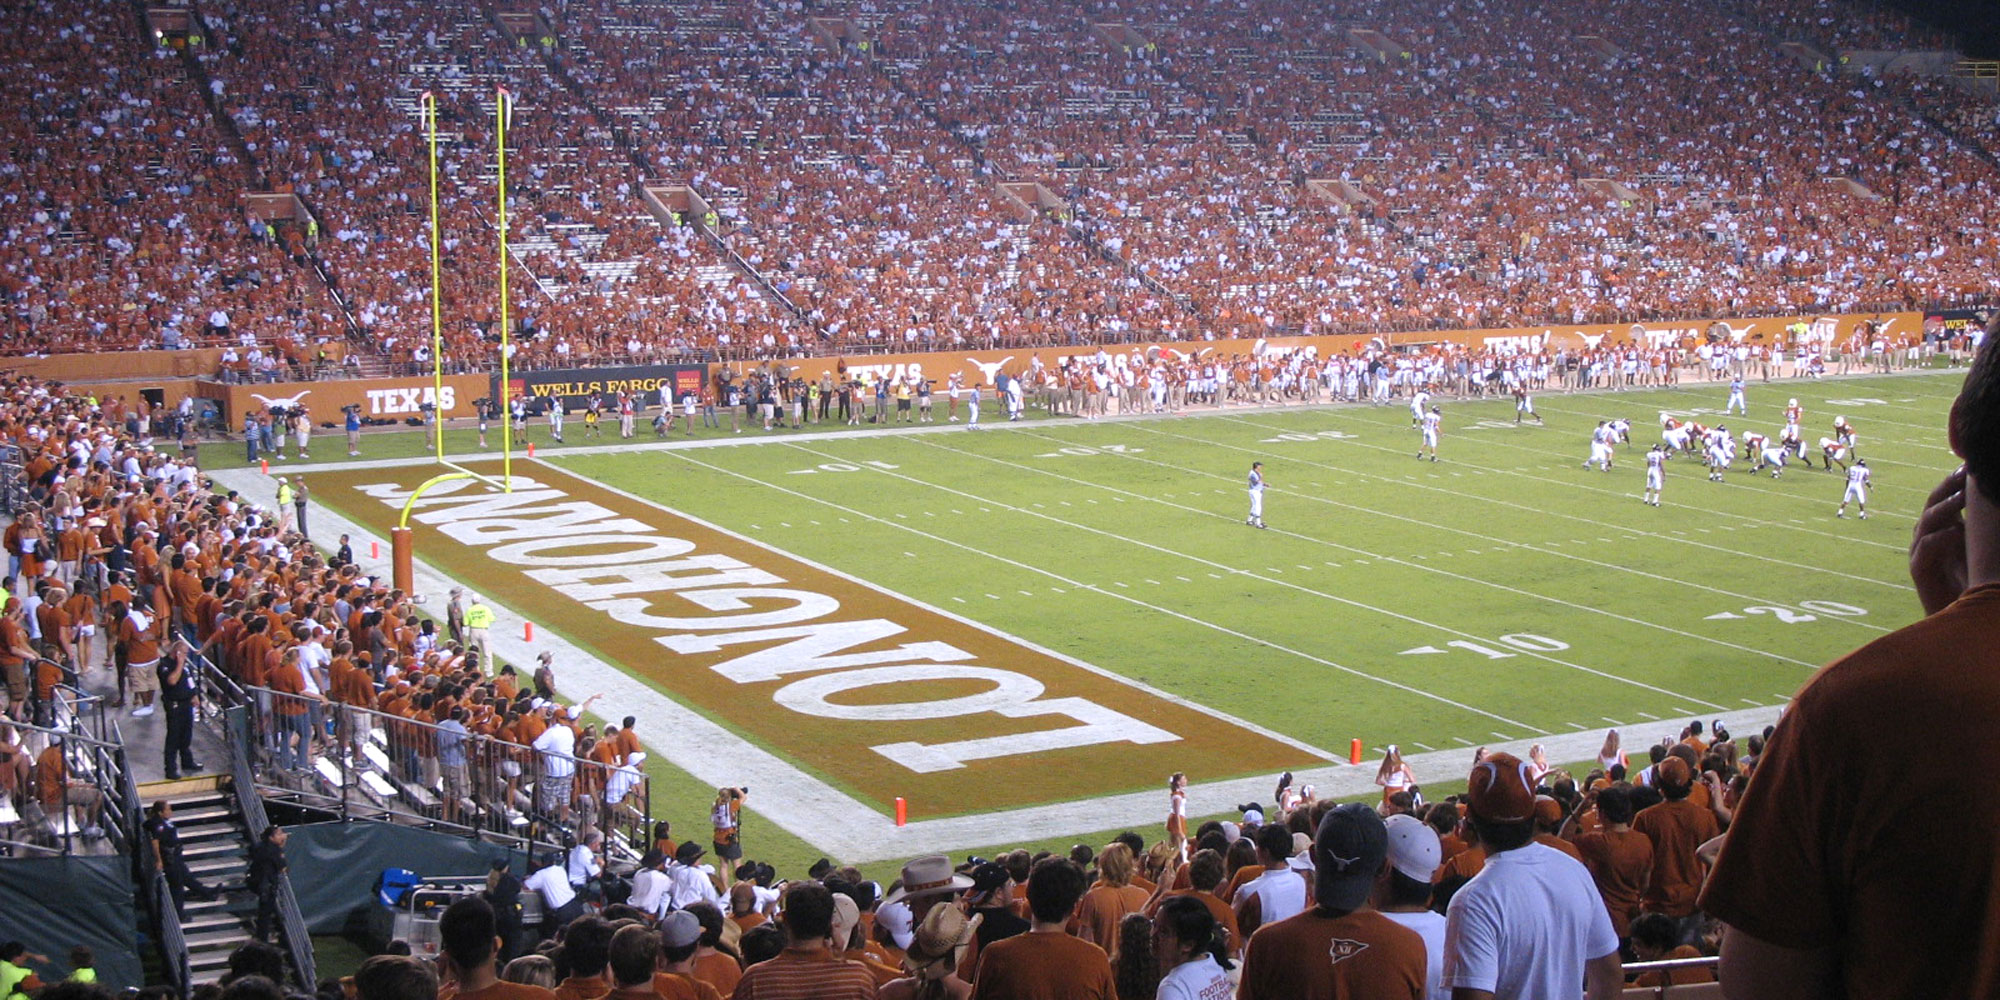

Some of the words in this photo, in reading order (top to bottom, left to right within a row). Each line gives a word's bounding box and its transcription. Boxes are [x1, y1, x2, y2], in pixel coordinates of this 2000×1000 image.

[531, 381, 600, 397] WELLS
[606, 377, 667, 394] FARGO
[846, 363, 922, 387] TEXAS
[366, 386, 455, 414] TEXAS
[817, 460, 899, 472] 10
[352, 475, 1183, 774] LONGHORNS
[1743, 601, 1868, 624] 20
[1447, 633, 1570, 659] 10
